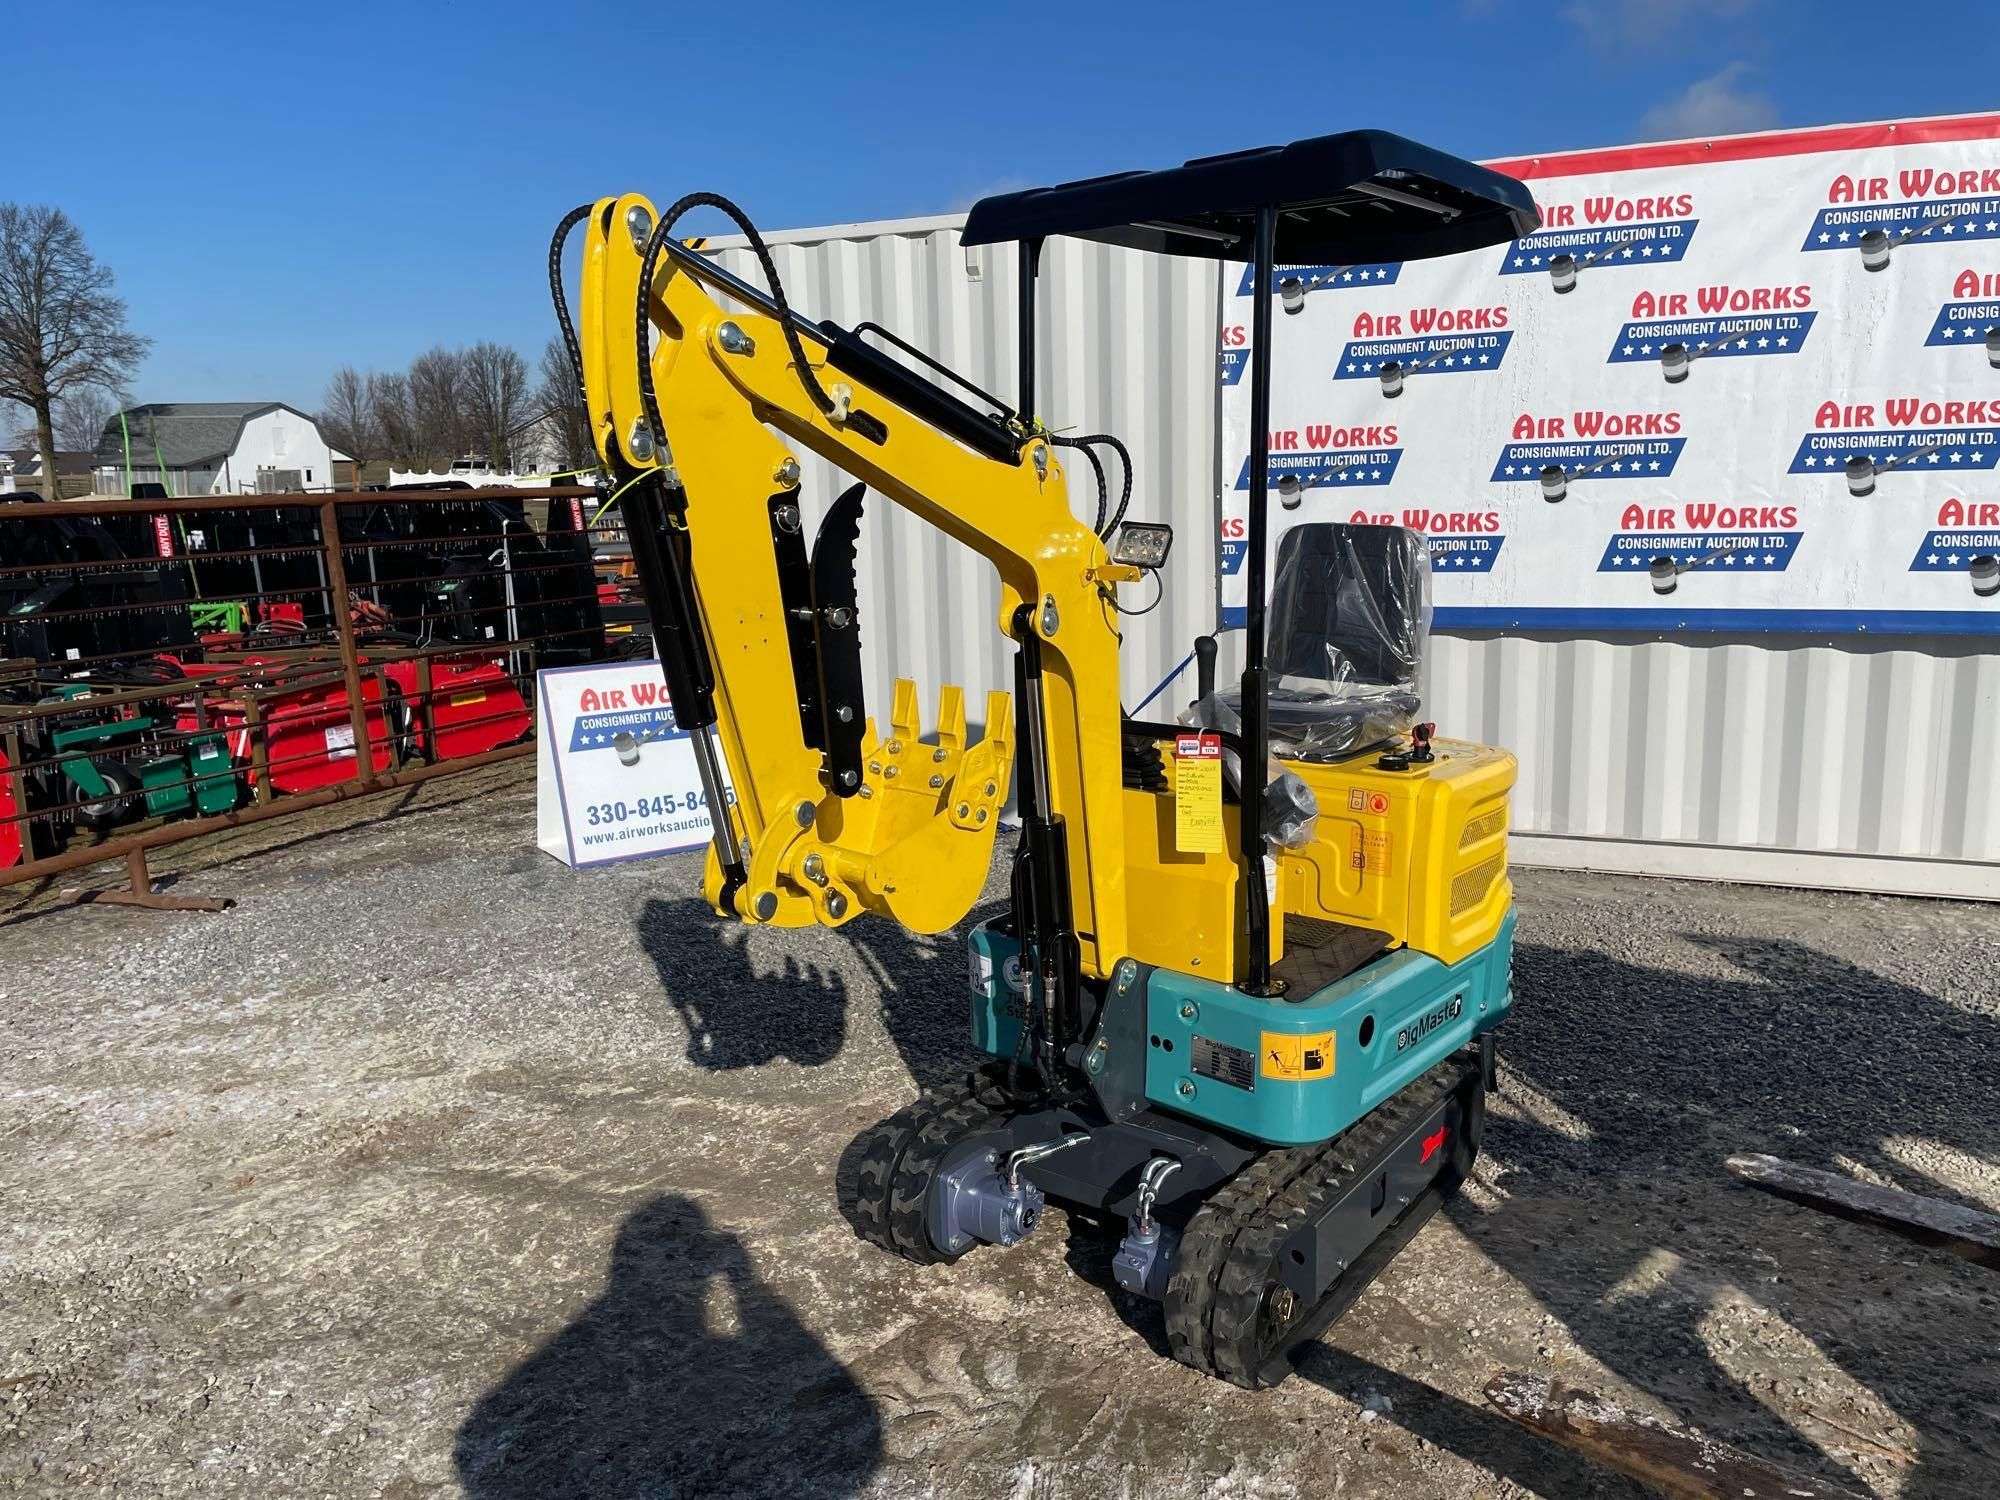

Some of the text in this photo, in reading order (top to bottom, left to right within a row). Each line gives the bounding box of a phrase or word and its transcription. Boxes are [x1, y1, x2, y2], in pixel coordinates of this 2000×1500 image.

[1829, 170, 2000, 202] AIR WORK
[1584, 194, 1692, 222] WORKS
[1825, 201, 2000, 225] CONSIGNMENT AUCTION LT
[1519, 226, 1683, 250] CONSIGNMENT AUCTION LTD.
[1632, 286, 1811, 318] AIR WORKS
[1949, 306, 1999, 320] CONSIG
[1353, 307, 1508, 337] AIR WORKS
[1628, 317, 1801, 338] CONSIGNMENT AUCTION LTD.
[1351, 336, 1500, 357] CONSIGNMENT AUCTION LTD.
[1513, 412, 1680, 439] AIR WORKS
[1815, 401, 1873, 428] AIR
[1268, 425, 1398, 450] IR WORKS
[1811, 432, 1996, 450] CONSIGNMENT AUCTION LTD.
[1324, 454, 1367, 466] AUCTION
[1370, 453, 1388, 464] LTD.
[1510, 443, 1671, 459] CONSIGNMENT AUCTION LTD.
[1403, 511, 1499, 533] WORKS
[1621, 504, 1797, 529] AIR WORKS
[1937, 499, 2000, 526] AIR
[1429, 540, 1491, 551] UCTION LTD.
[1618, 537, 1787, 549] CONSIGNMENT AUCTION LTD.
[580, 689, 624, 711] AIR
[582, 713, 652, 729] CONSIGNMENT
[586, 786, 735, 826] 330-845-845
[583, 817, 710, 845] www.airworksauctio
